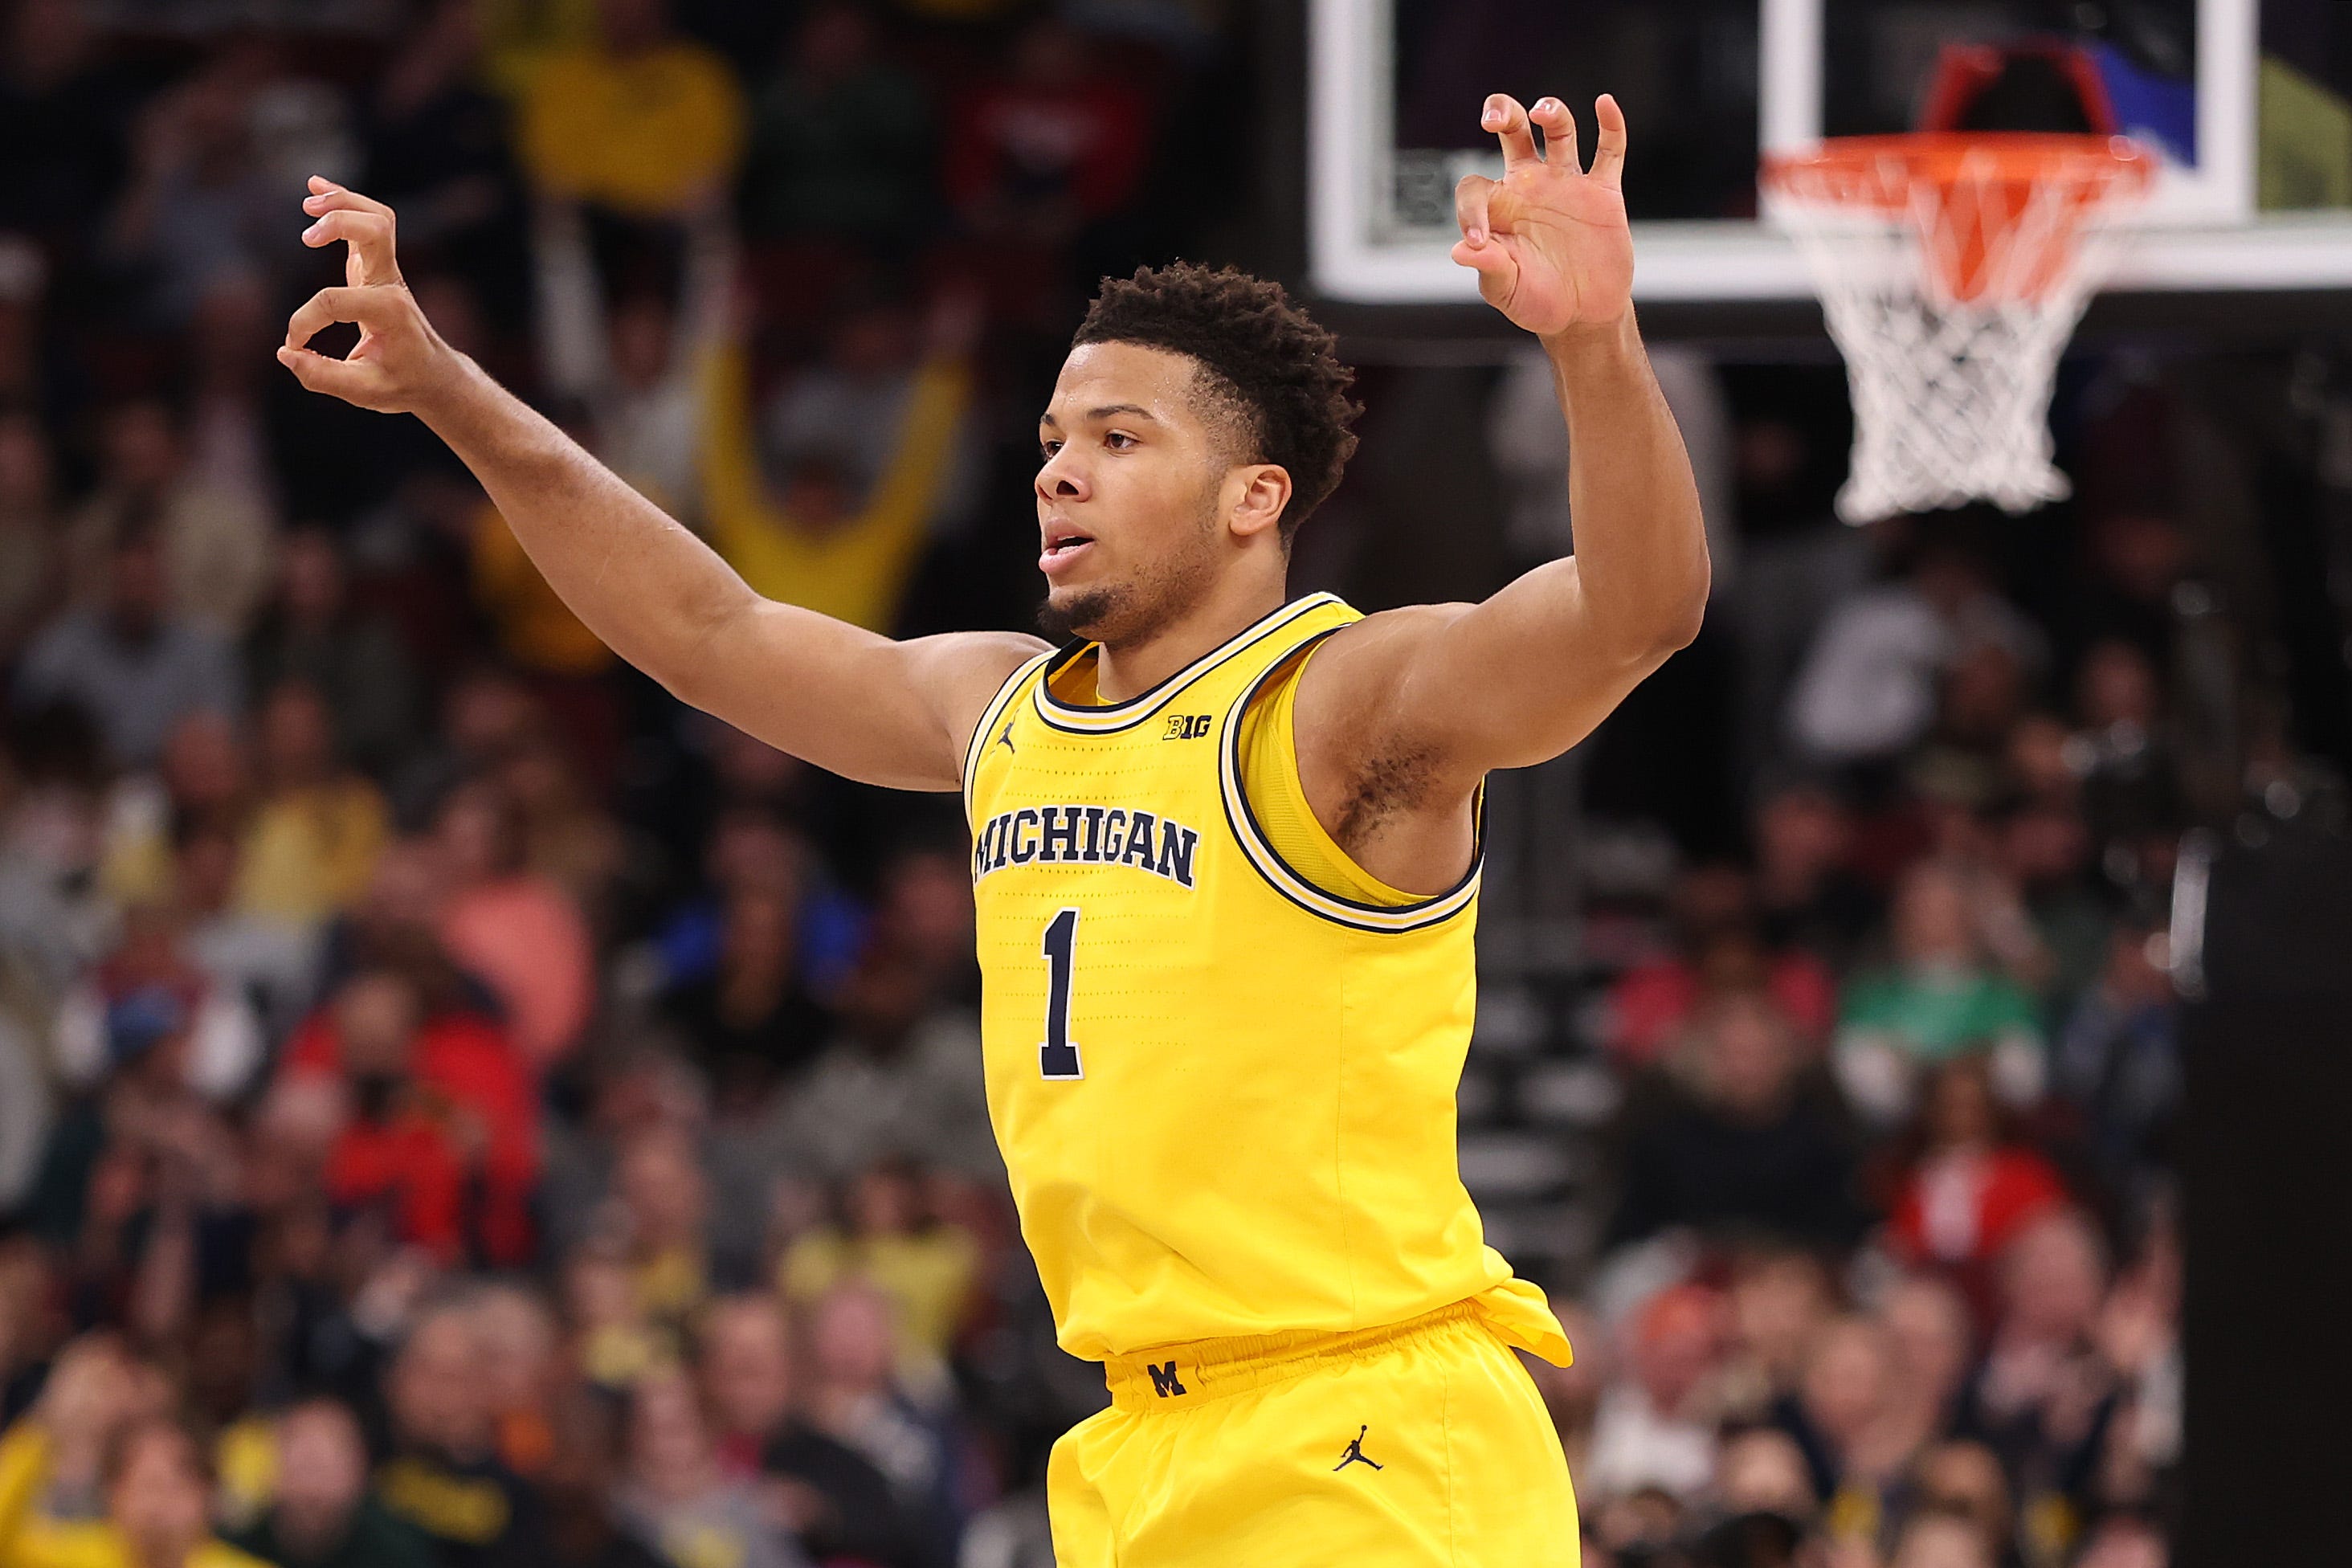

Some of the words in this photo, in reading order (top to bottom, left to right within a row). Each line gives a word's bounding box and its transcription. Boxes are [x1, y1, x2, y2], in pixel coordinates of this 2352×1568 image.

[975, 806, 1200, 889] MICHIGAN
[1039, 907, 1084, 1080] 1
[1147, 1361, 1187, 1398] M
